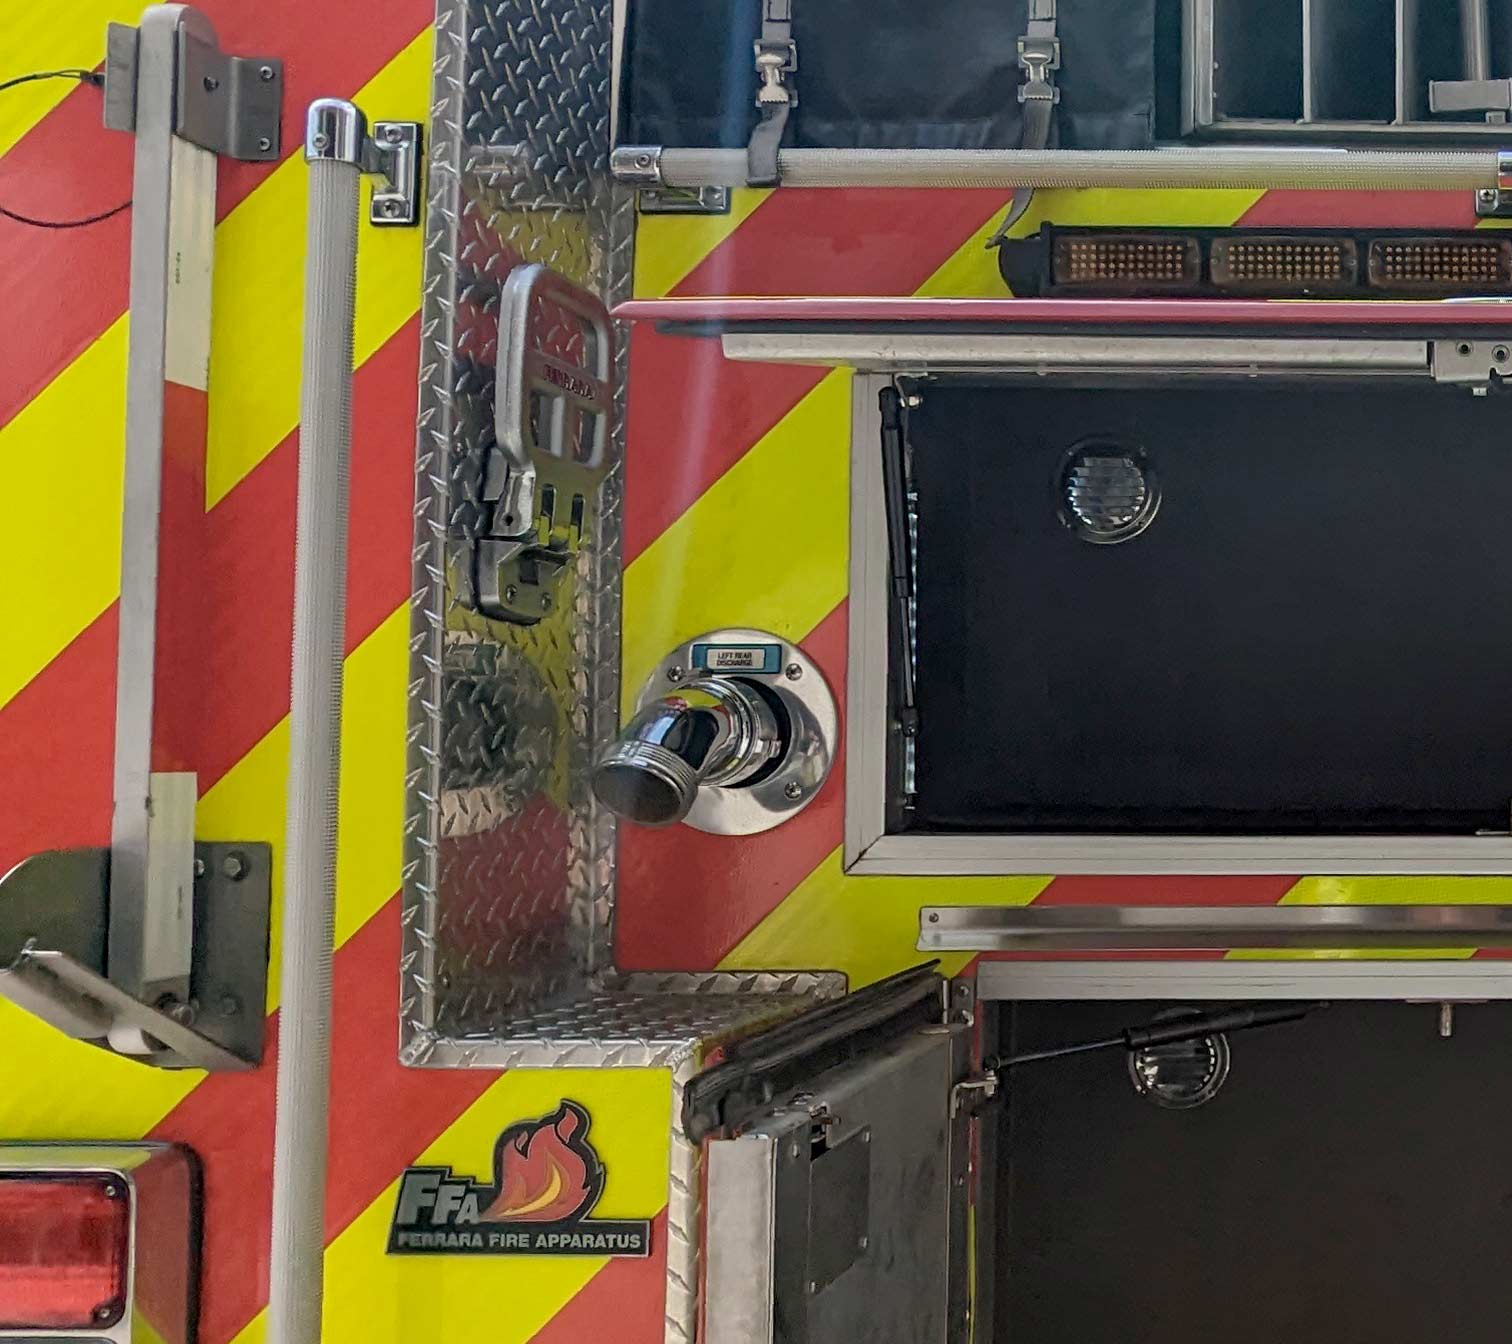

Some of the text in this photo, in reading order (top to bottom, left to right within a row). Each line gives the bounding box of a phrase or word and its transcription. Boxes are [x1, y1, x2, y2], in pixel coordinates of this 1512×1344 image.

[717, 651, 753, 659] LEFT REAR
[397, 1173, 480, 1224] FFA
[398, 1233, 641, 1248] FERRARA FIRE APPARATUS
